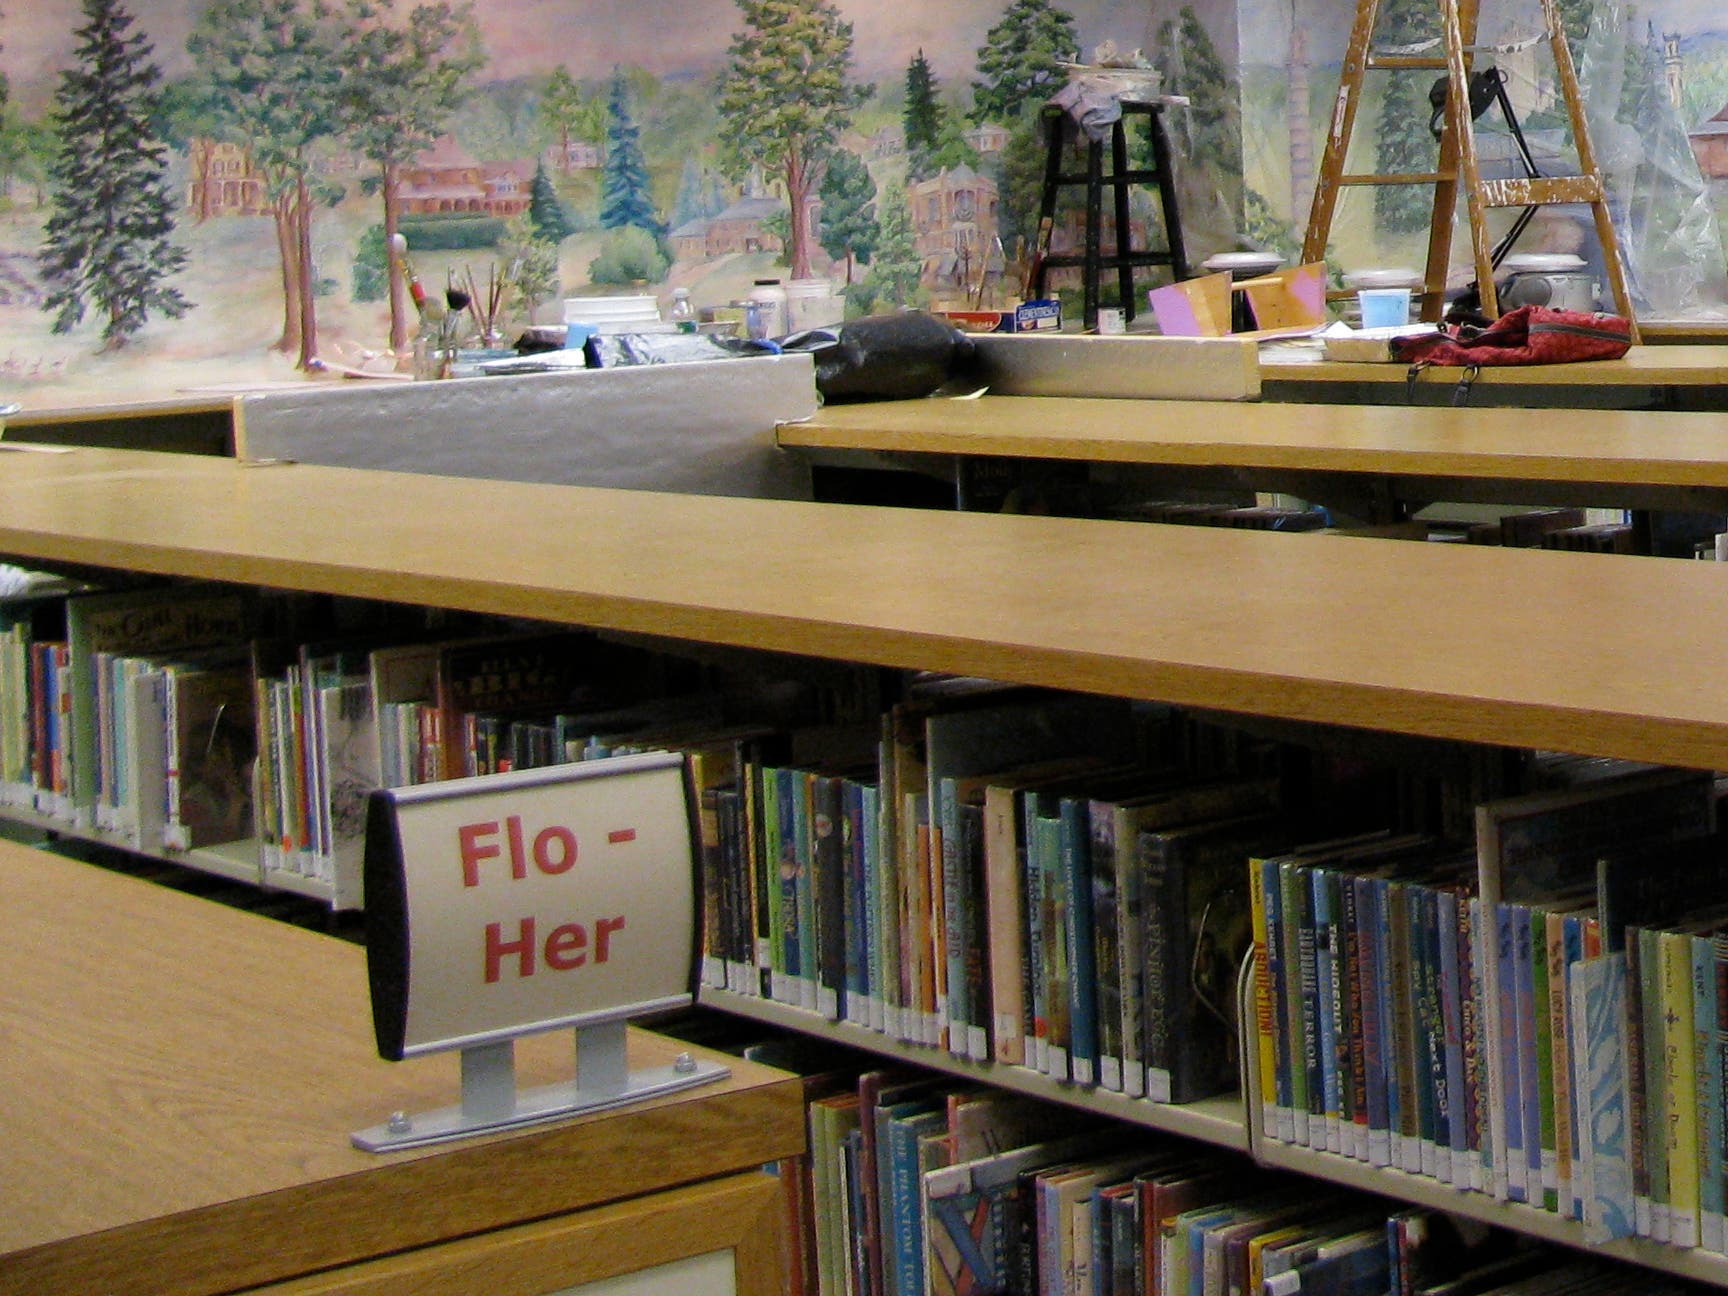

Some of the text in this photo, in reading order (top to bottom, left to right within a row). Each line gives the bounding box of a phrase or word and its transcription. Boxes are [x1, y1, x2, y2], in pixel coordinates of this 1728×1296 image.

[457, 814, 637, 888] Flo -
[483, 914, 627, 985] Her
[1328, 923, 1339, 953] THE
[1330, 959, 1343, 1034] HIDEOUT
[1303, 998, 1317, 1070] TERROR
[1427, 1031, 1442, 1073] Next
[899, 1168, 914, 1254] PHANTOM
